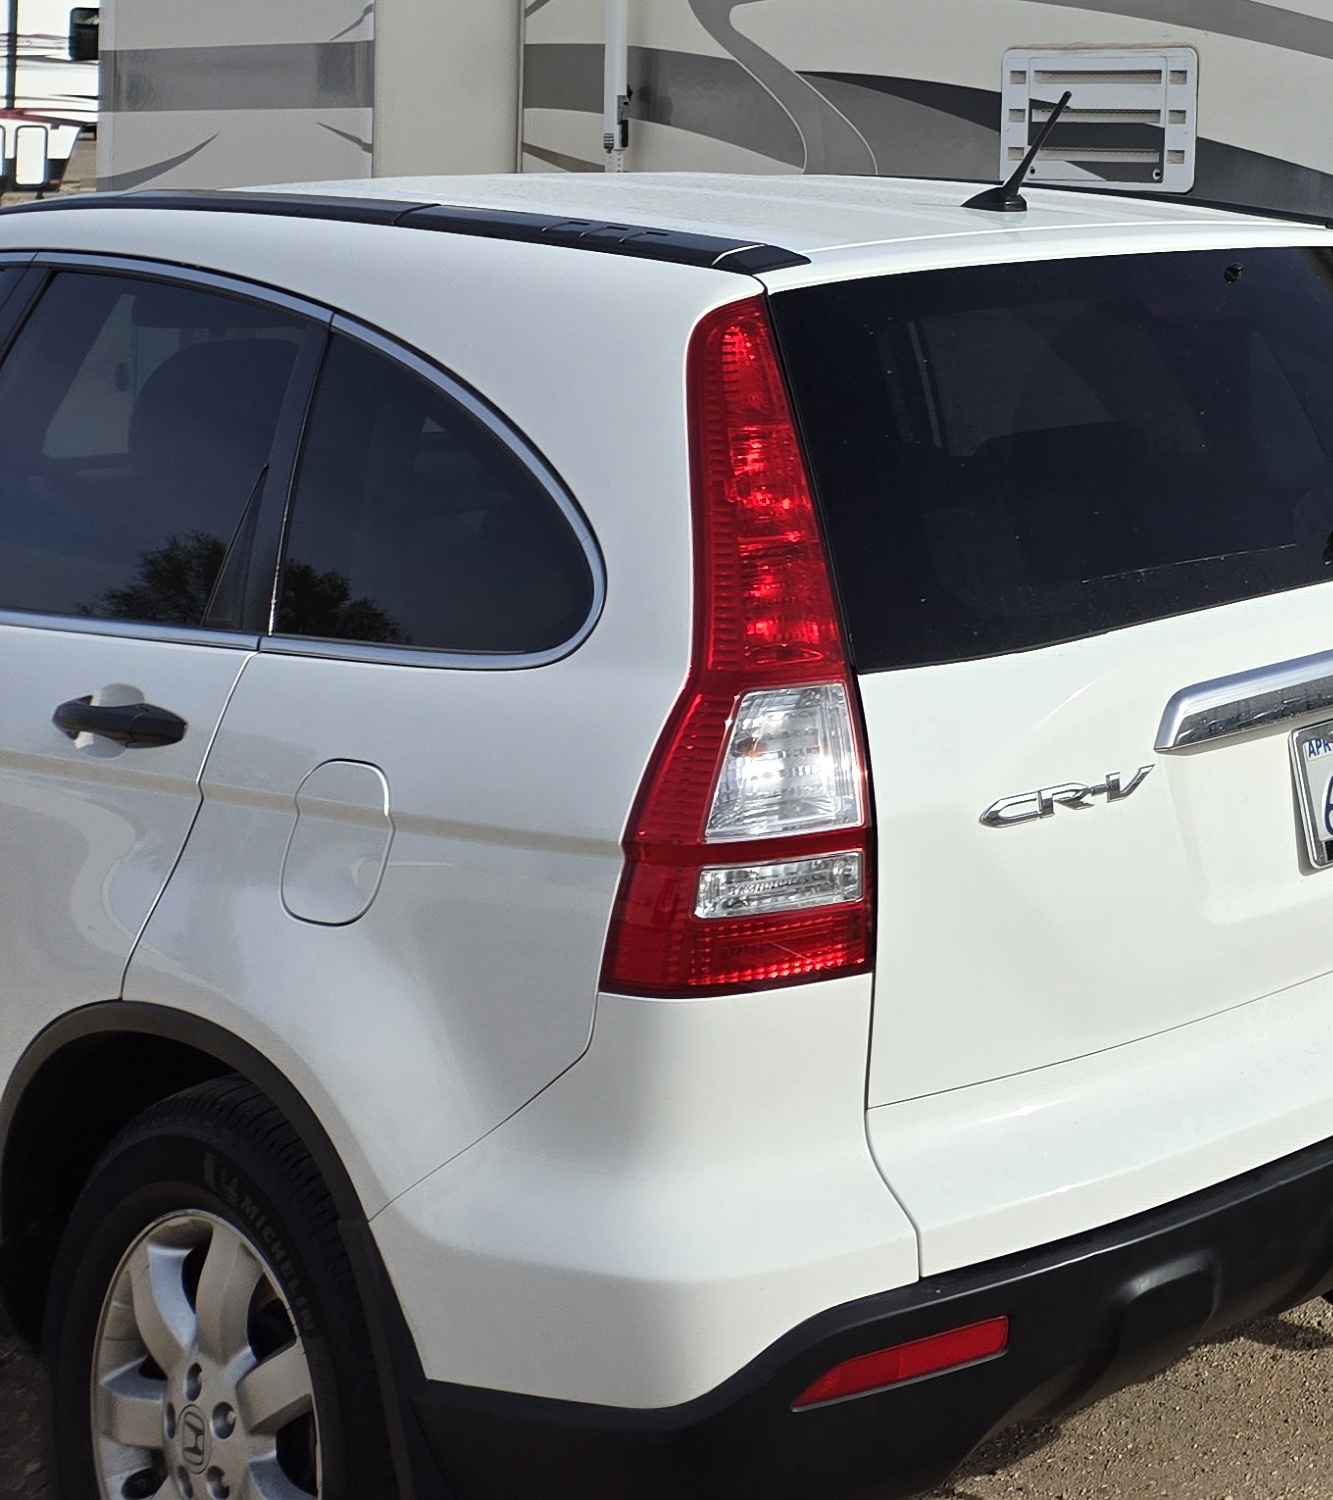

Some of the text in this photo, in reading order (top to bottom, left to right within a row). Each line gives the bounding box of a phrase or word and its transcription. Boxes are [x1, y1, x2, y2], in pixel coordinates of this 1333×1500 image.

[1308, 739, 1332, 758] APR
[978, 763, 1155, 829] CR-V
[239, 1195, 315, 1331] MICHELIN
